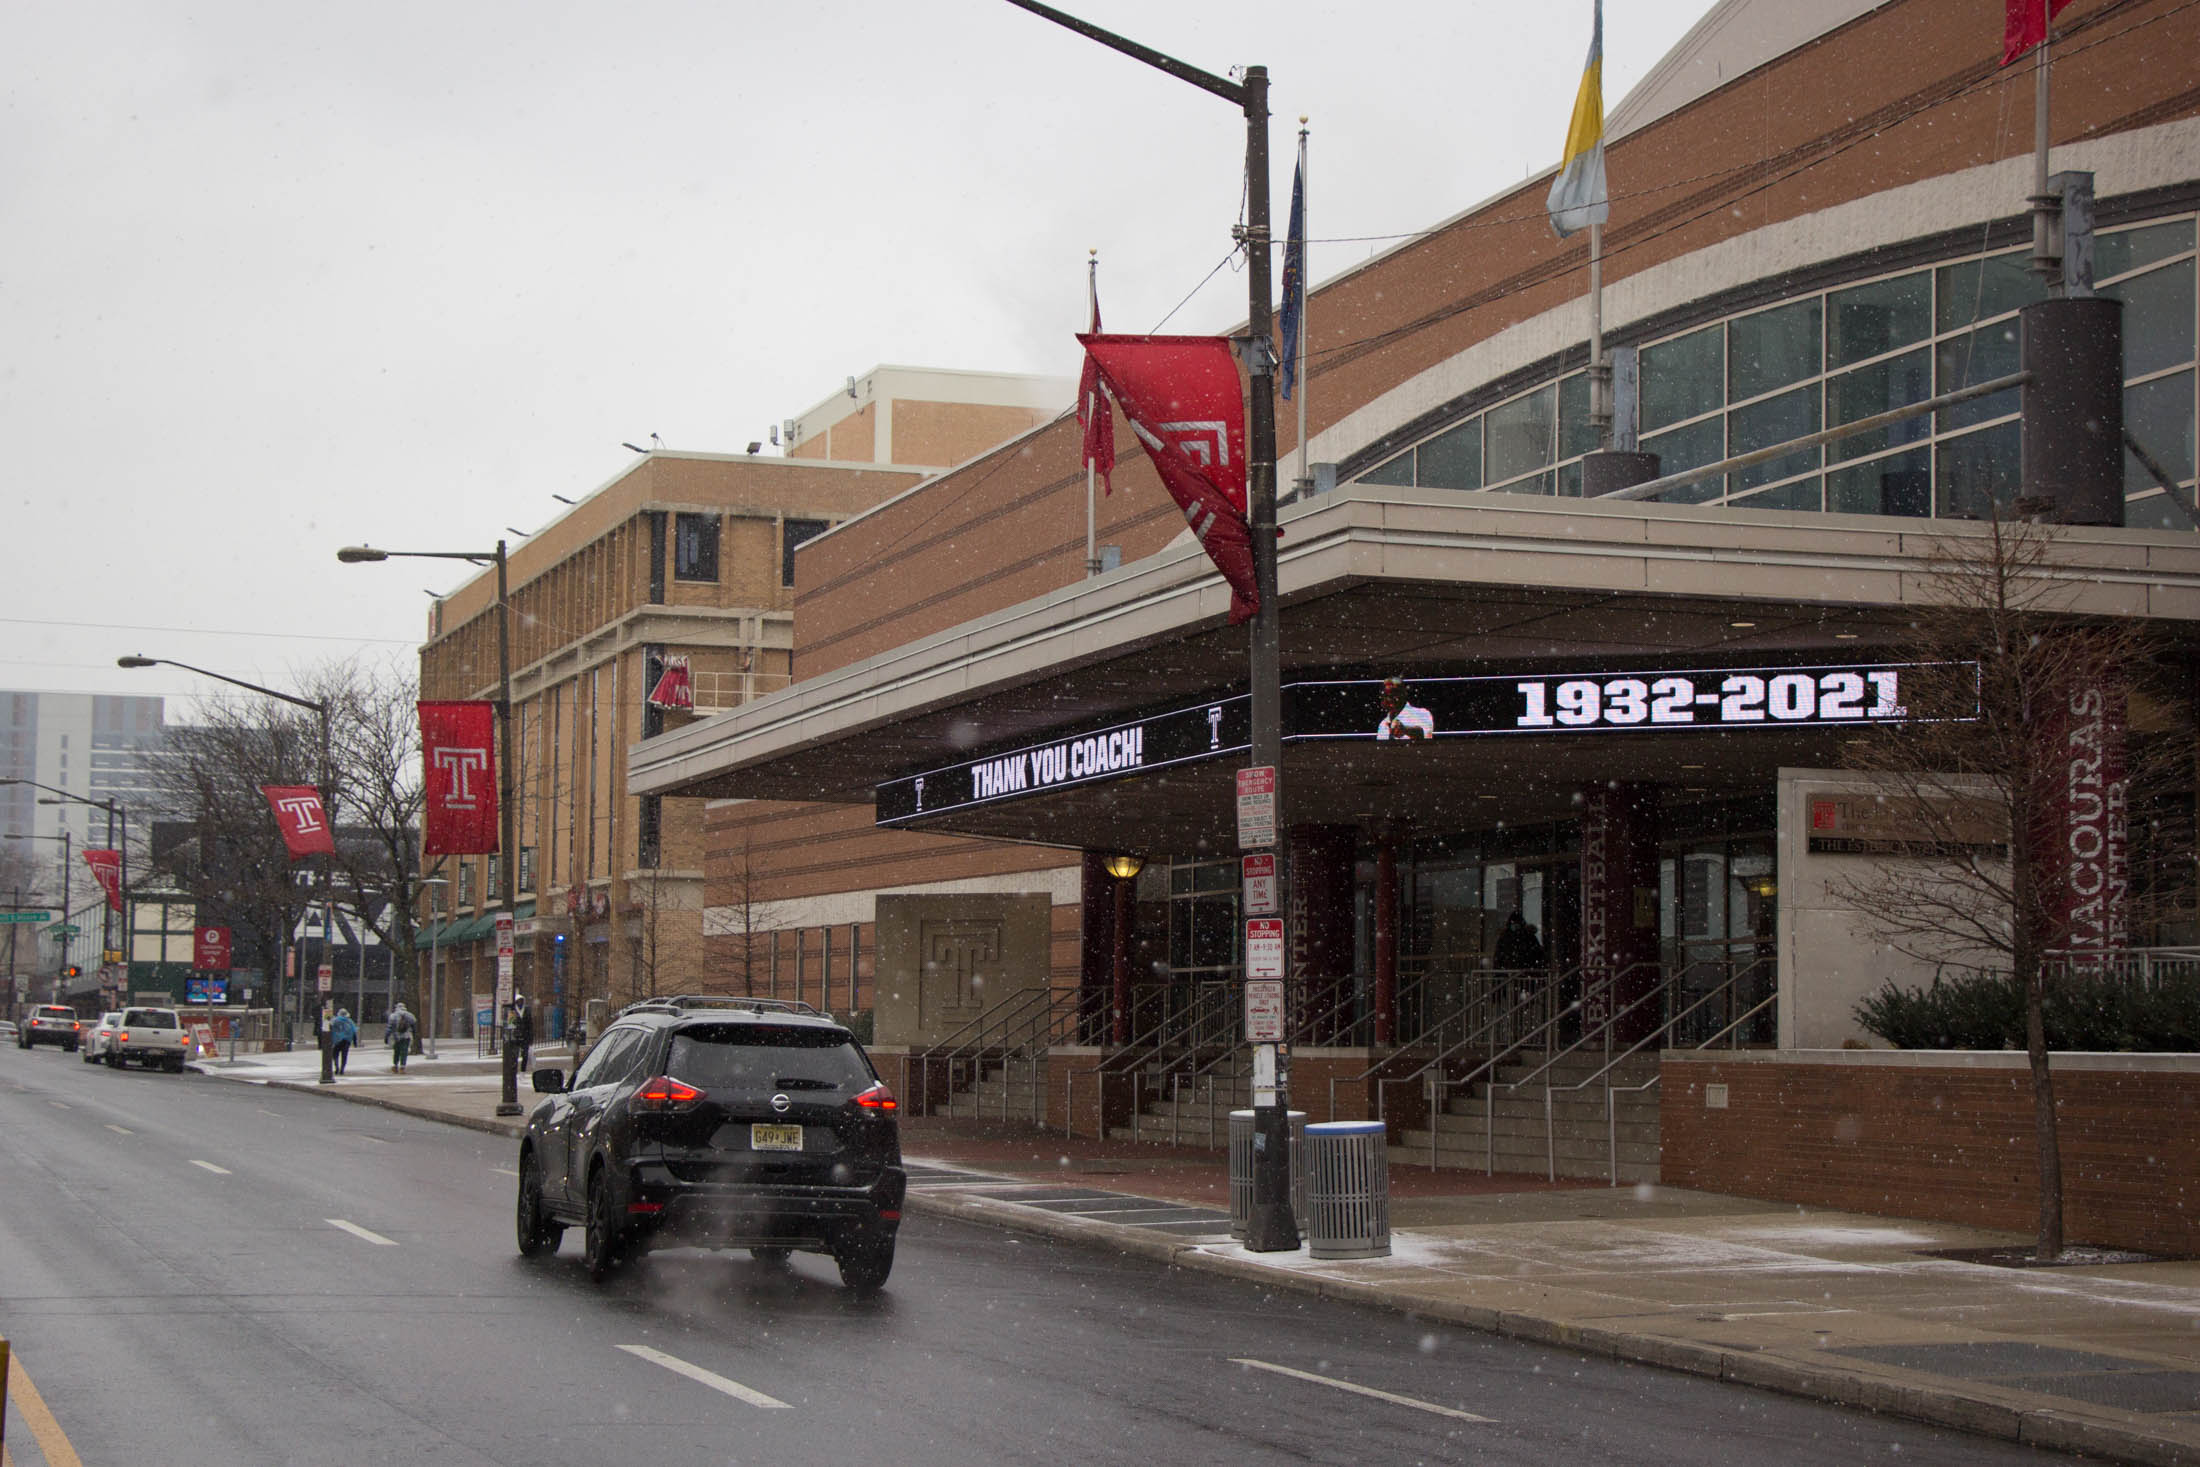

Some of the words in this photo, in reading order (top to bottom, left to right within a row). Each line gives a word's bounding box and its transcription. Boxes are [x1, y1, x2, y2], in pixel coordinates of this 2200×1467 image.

[1517, 671, 1907, 726] 1932-2021
[972, 752, 1027, 799] THANK
[1031, 744, 1067, 786] YOU
[1071, 726, 1143, 777] COACH!
[1245, 770, 1265, 778] SNOW
[1238, 777, 1273, 787] EMERGENCY
[1244, 785, 1265, 793] ROUTE
[1254, 857, 1263, 865] NO
[1246, 866, 1273, 876] STOPPING
[1253, 879, 1267, 889] ANY
[1253, 890, 1268, 900] TIME
[1587, 792, 1607, 1024] BASKETBALL
[1259, 921, 1270, 930] NO
[1249, 929, 1280, 939] STOPPING
